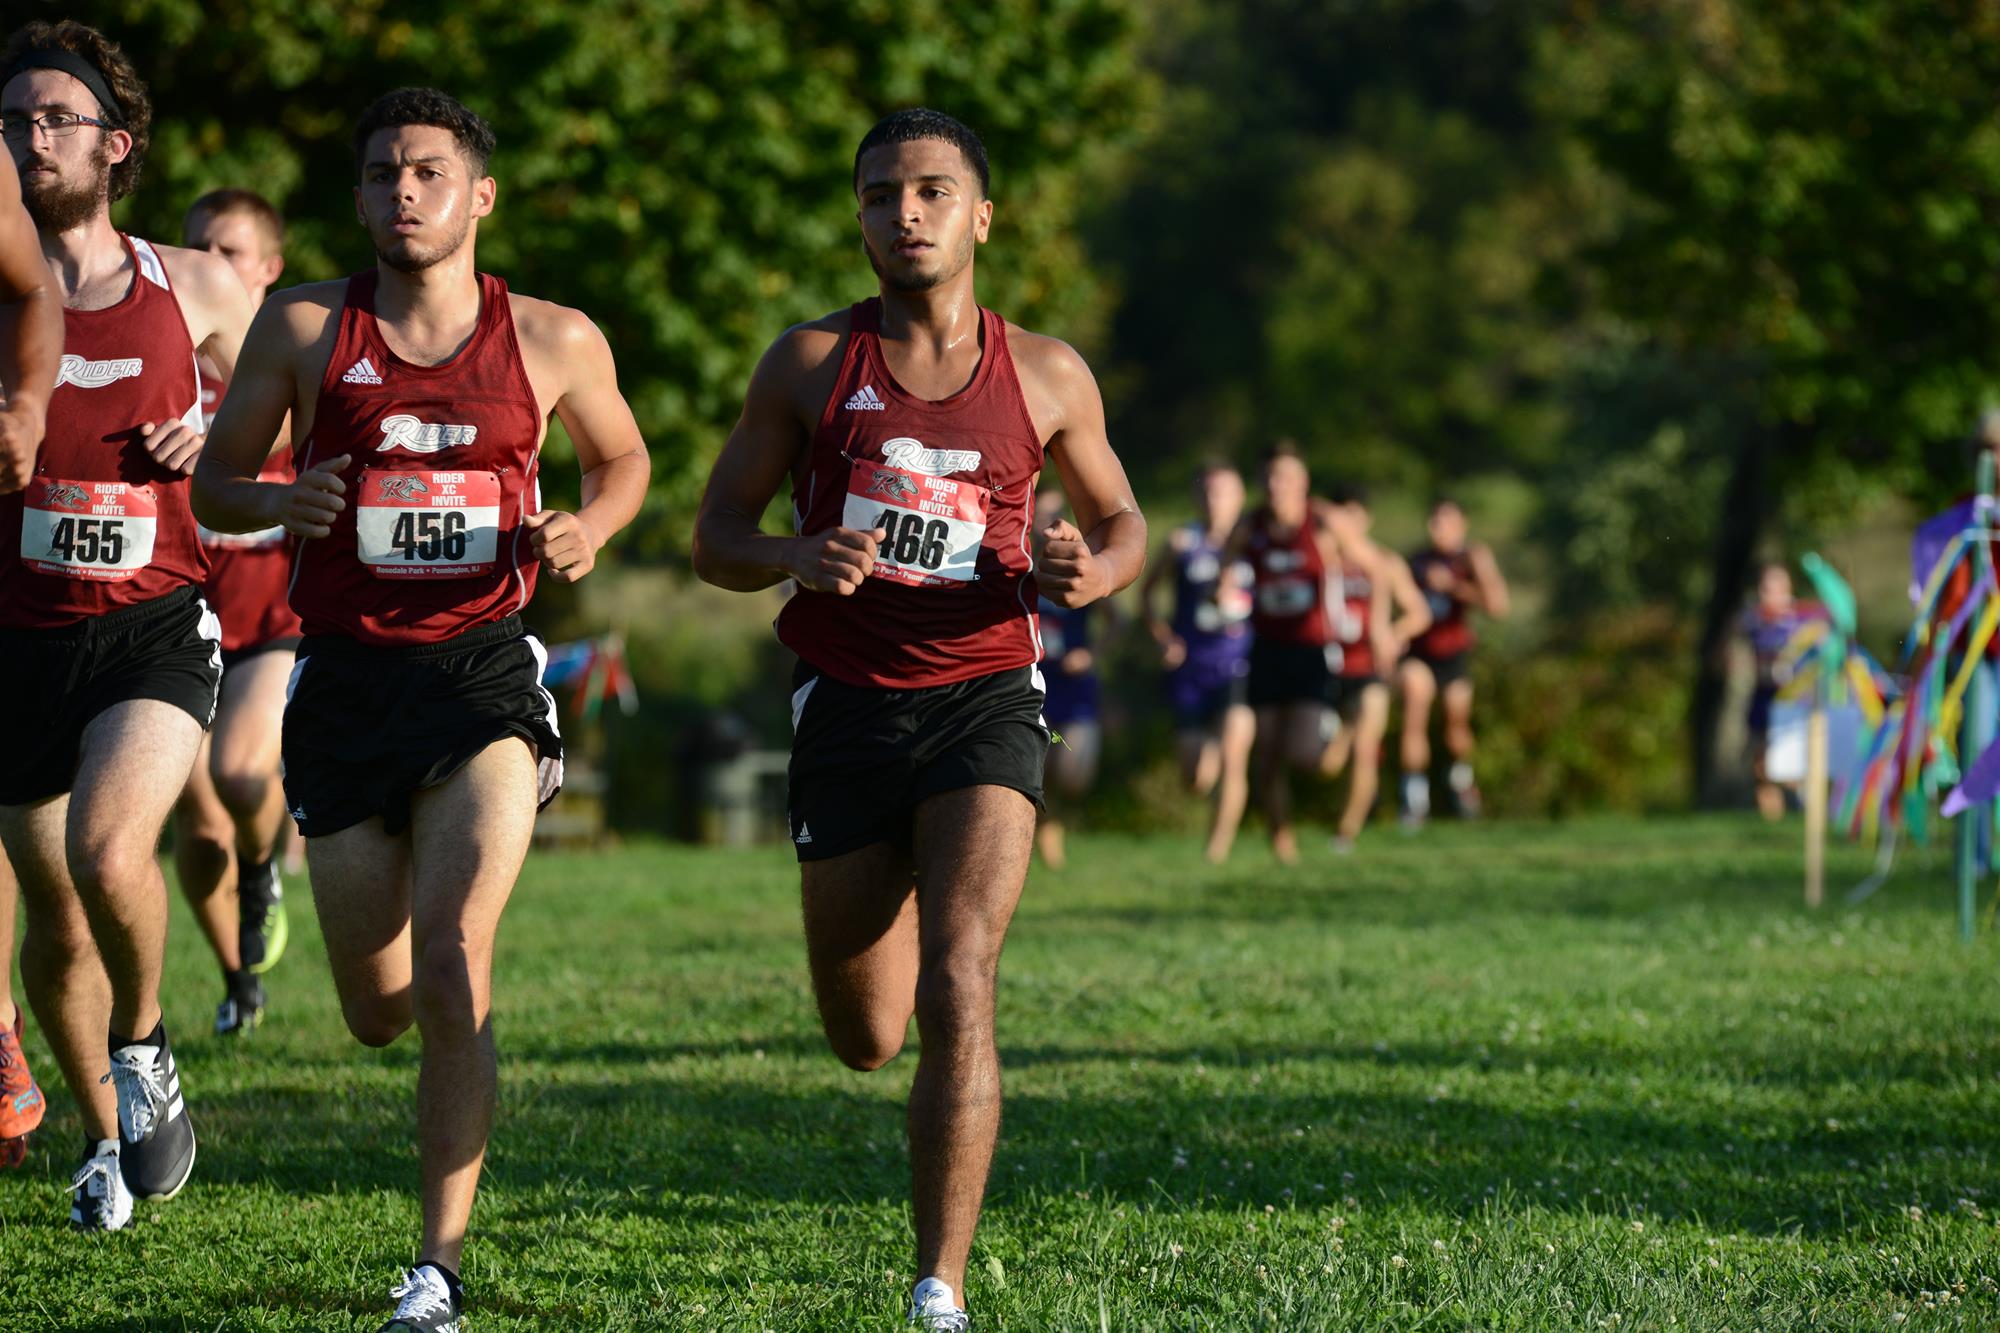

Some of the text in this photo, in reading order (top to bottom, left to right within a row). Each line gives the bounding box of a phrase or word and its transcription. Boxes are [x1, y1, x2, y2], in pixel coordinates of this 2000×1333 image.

[53, 354, 143, 388] RIDER
[342, 373, 382, 384] adidas
[845, 400, 885, 411] adidas
[376, 414, 478, 453] RIDER
[881, 437, 981, 477] RIDER
[432, 473, 465, 484] RIDER
[94, 484, 126, 495] RIDER
[441, 484, 456, 495] XC
[924, 477, 958, 494] RIDER
[102, 495, 117, 505] XC
[431, 495, 467, 506] INVITE
[930, 490, 947, 503] XC
[92, 504, 126, 516] INVITE
[918, 500, 955, 517] INVITE
[52, 517, 124, 564] 455
[391, 511, 466, 561] 456
[875, 508, 949, 571] 466
[66, 567, 80, 575] Park
